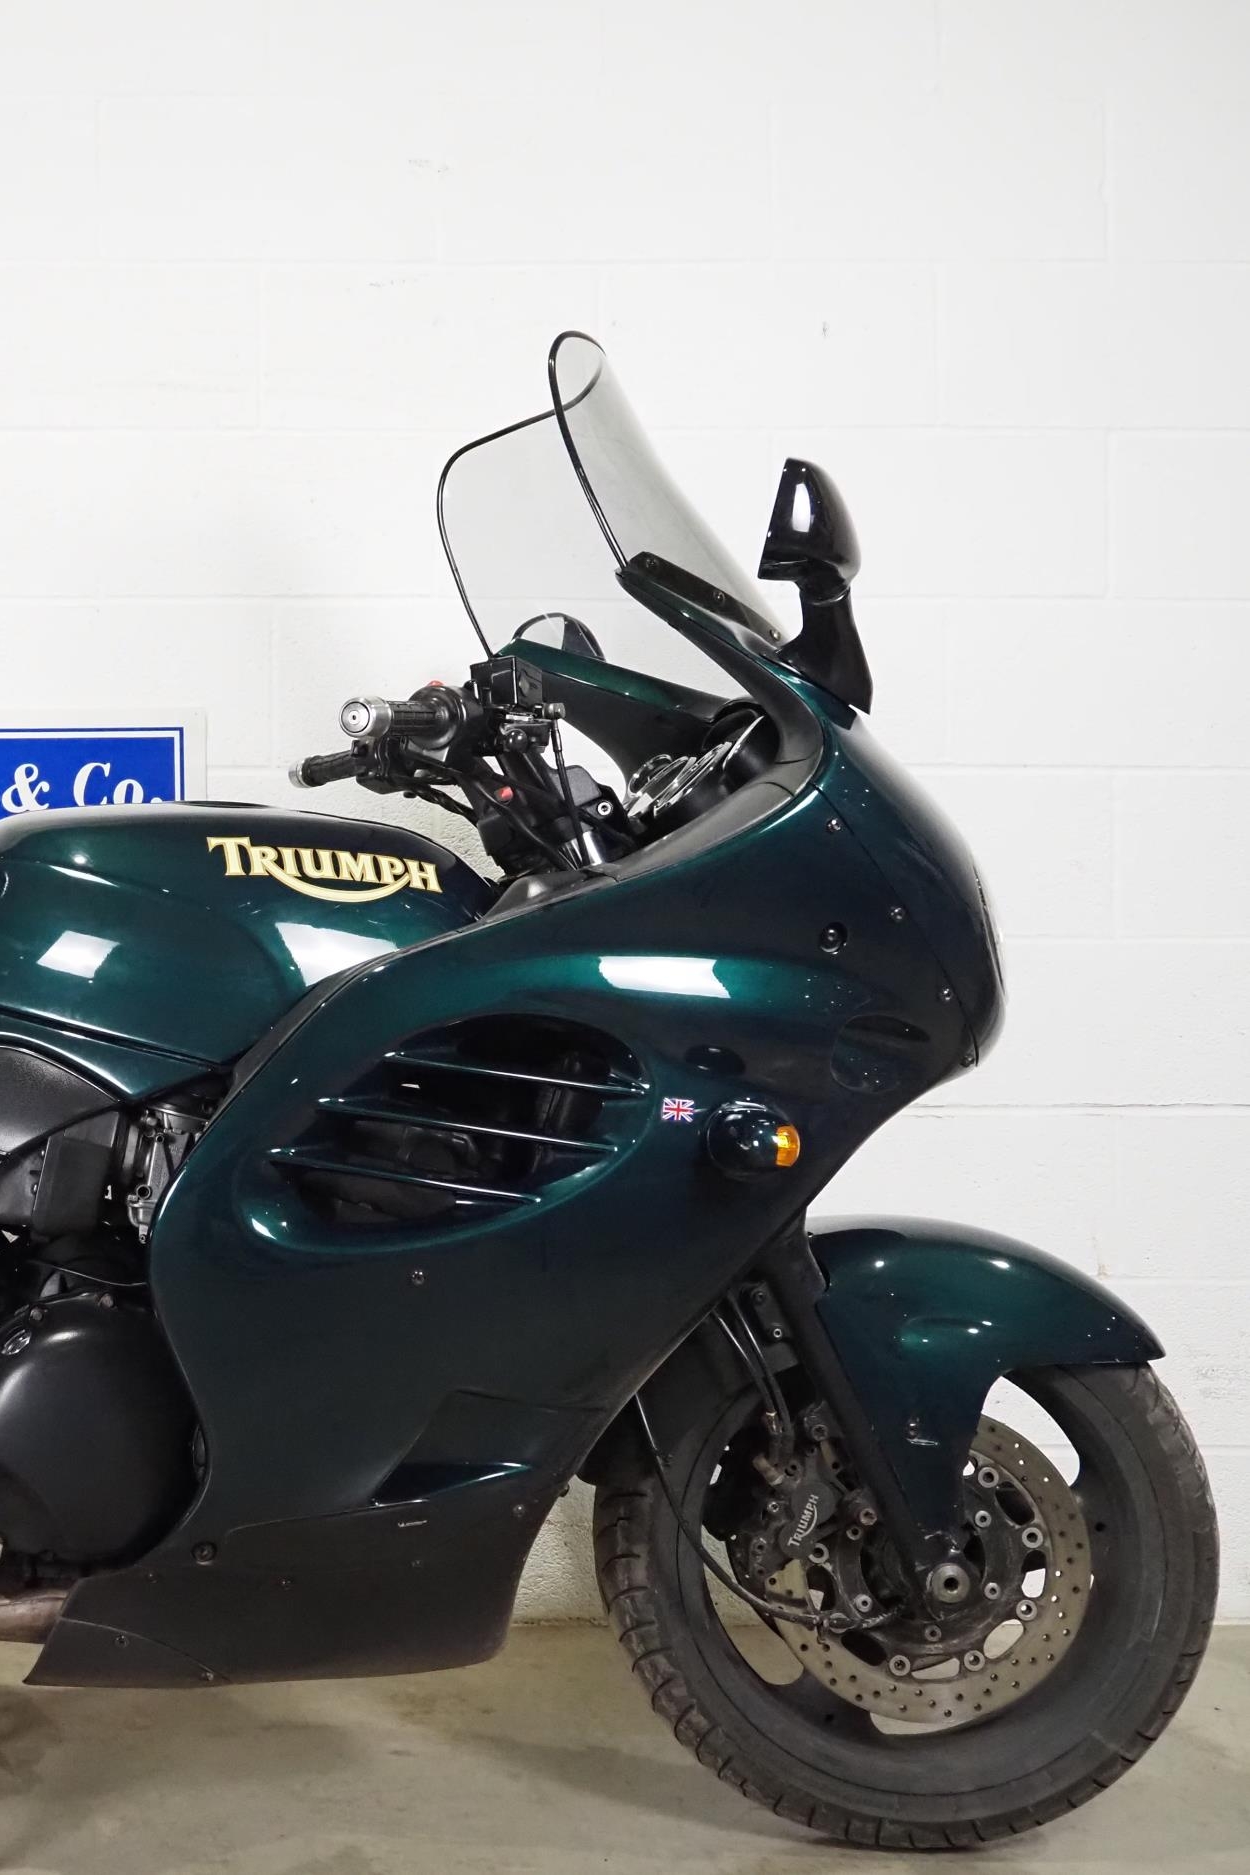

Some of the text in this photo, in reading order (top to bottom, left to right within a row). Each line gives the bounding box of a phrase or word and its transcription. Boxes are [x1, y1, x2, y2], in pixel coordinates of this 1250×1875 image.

[1, 763, 50, 814] &
[73, 762, 164, 807] Co.
[206, 836, 443, 903] TRIUMPH
[786, 1494, 819, 1547] TRIUMPH
